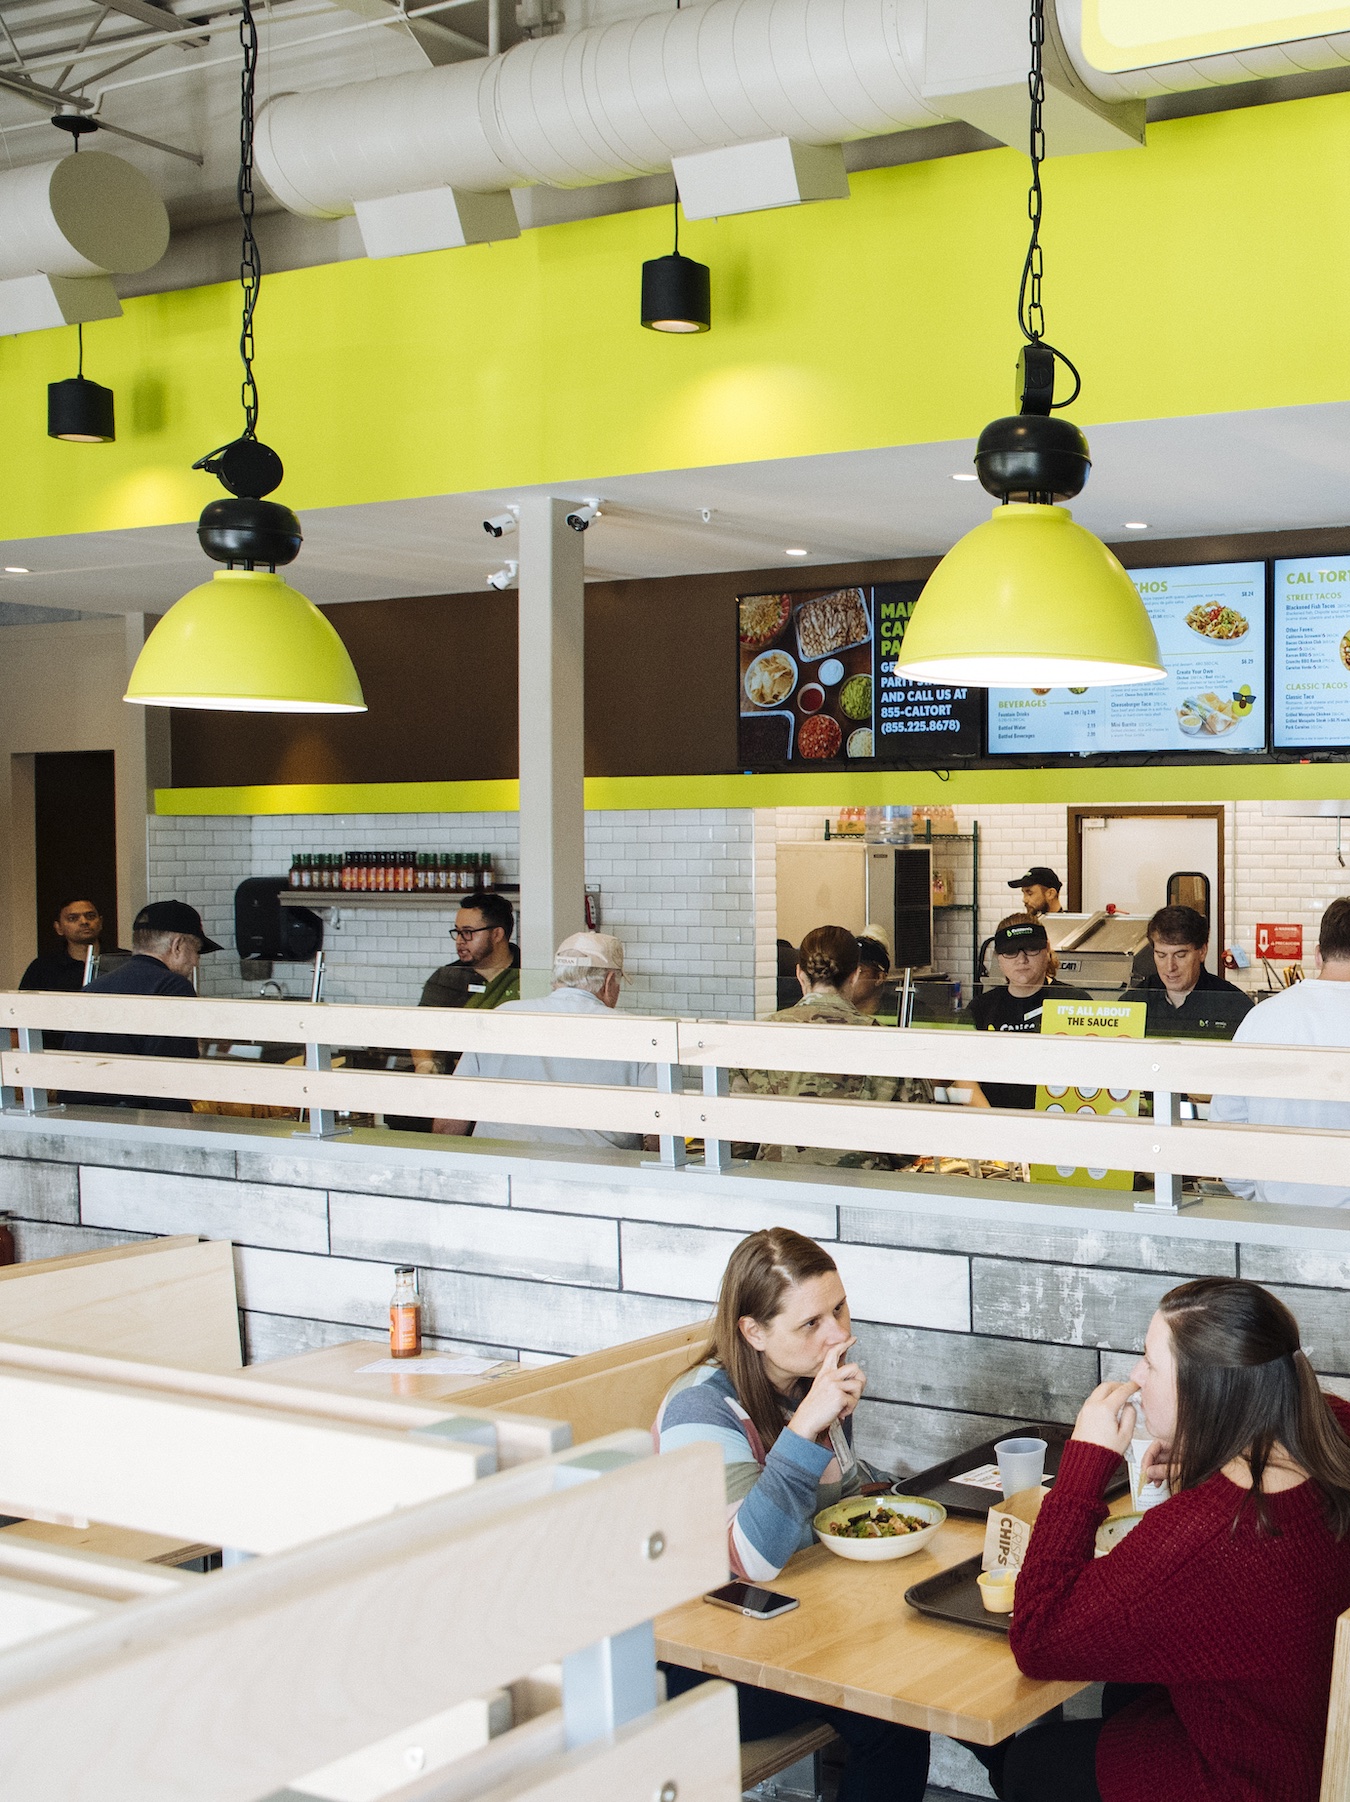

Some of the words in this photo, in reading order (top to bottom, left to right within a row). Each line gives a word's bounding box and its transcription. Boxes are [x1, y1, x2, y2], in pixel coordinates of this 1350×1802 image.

[1286, 572, 1314, 585] CAL
[1286, 593, 1313, 601] STREET
[1316, 592, 1341, 600] TACOS
[881, 691, 905, 703] AND
[907, 689, 934, 702] CALL
[936, 689, 952, 700] US
[953, 688, 968, 700] AT
[881, 704, 952, 718] 855-CALTORT
[998, 700, 1047, 709] BEVERAGES
[881, 719, 960, 735] (855.225.8678)
[1057, 1006, 1074, 1015] IT'S
[1076, 1006, 1094, 1016] ALL
[1096, 1007, 1131, 1017] ABOUT
[1067, 1017, 1084, 1026] THE
[1087, 1018, 1119, 1027] SAUCE
[997, 1517, 1012, 1566] CHIPS
[1009, 1521, 1024, 1570] CRISPY
